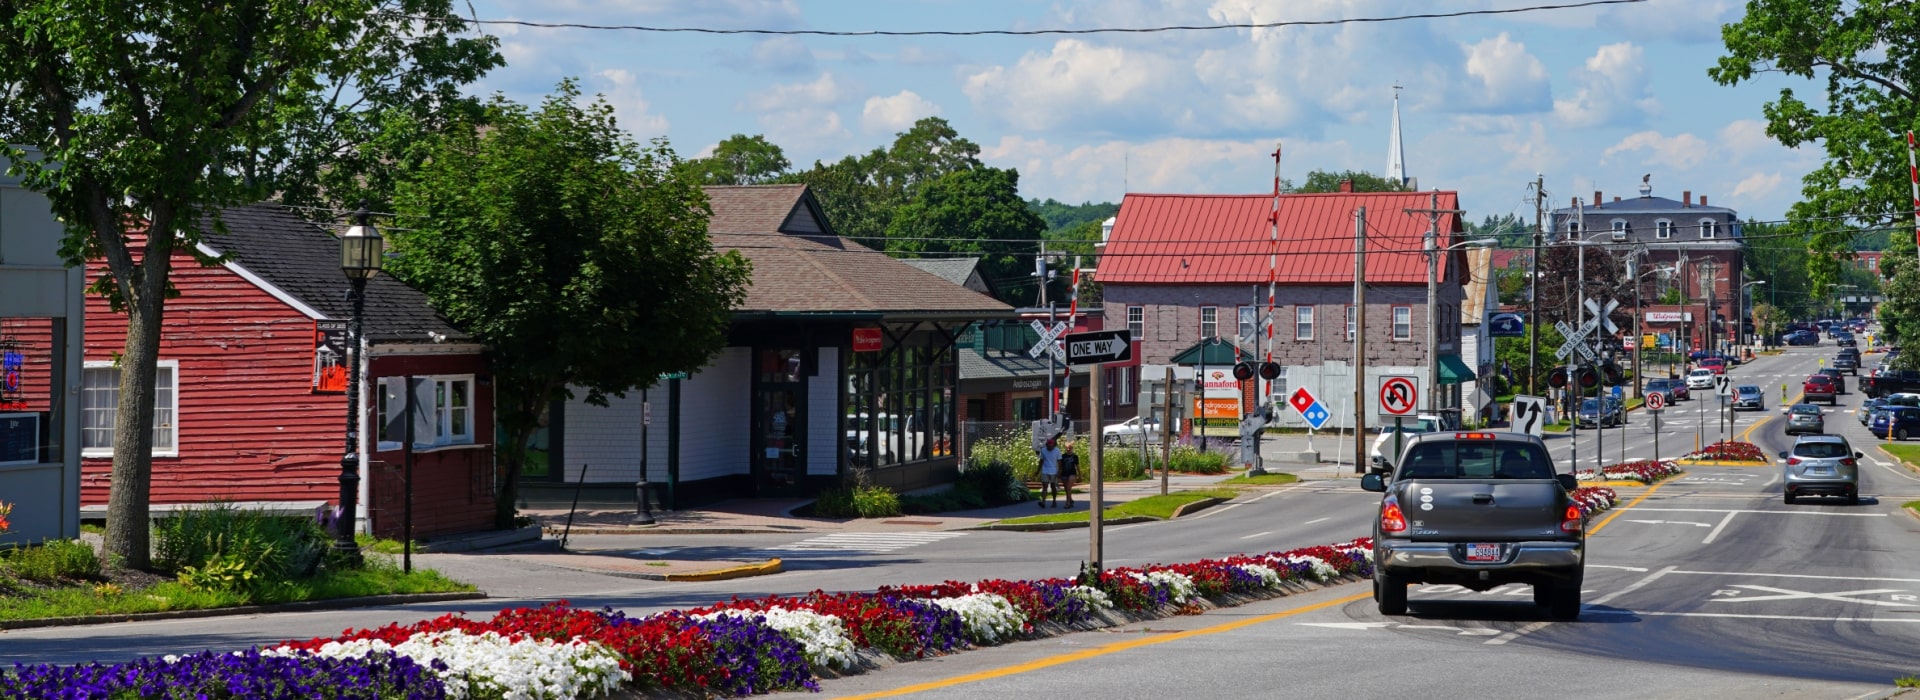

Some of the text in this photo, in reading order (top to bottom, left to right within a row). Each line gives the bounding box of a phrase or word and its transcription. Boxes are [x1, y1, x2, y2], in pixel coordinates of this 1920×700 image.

[1032, 321, 1064, 357] RAIL ROAD
[1032, 323, 1064, 355] CROSSING
[1072, 341, 1112, 356] ONE WAY
[1557, 322, 1593, 358] RAIL ROAD
[1558, 323, 1591, 357] CROSSING
[1198, 380, 1237, 388] annaford
[1891, 594, 1919, 602] R
